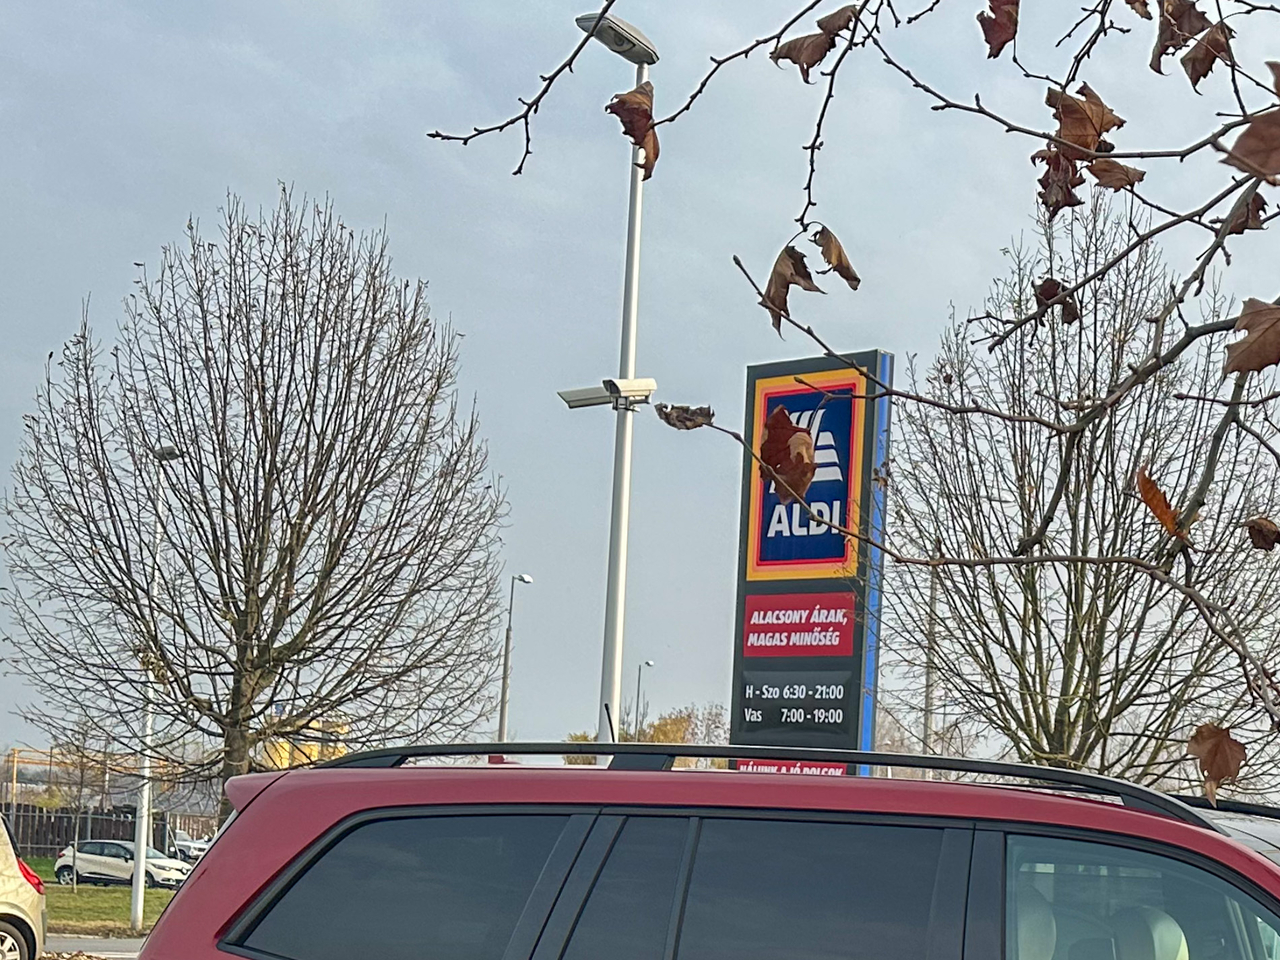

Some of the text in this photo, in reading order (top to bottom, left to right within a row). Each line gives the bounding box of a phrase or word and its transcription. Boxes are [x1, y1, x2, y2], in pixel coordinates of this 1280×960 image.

[767, 500, 841, 537] ALDI
[750, 605, 848, 625] ALACSONY ÁRAK,
[747, 627, 840, 646] MAGAS MINŐSÉG
[745, 685, 754, 699] H
[761, 685, 779, 699] Szo
[783, 685, 807, 699] 6:30
[814, 685, 844, 700] 21:00
[744, 708, 763, 722] Vas
[781, 708, 805, 723] 7:00
[813, 709, 843, 724] 19:00
